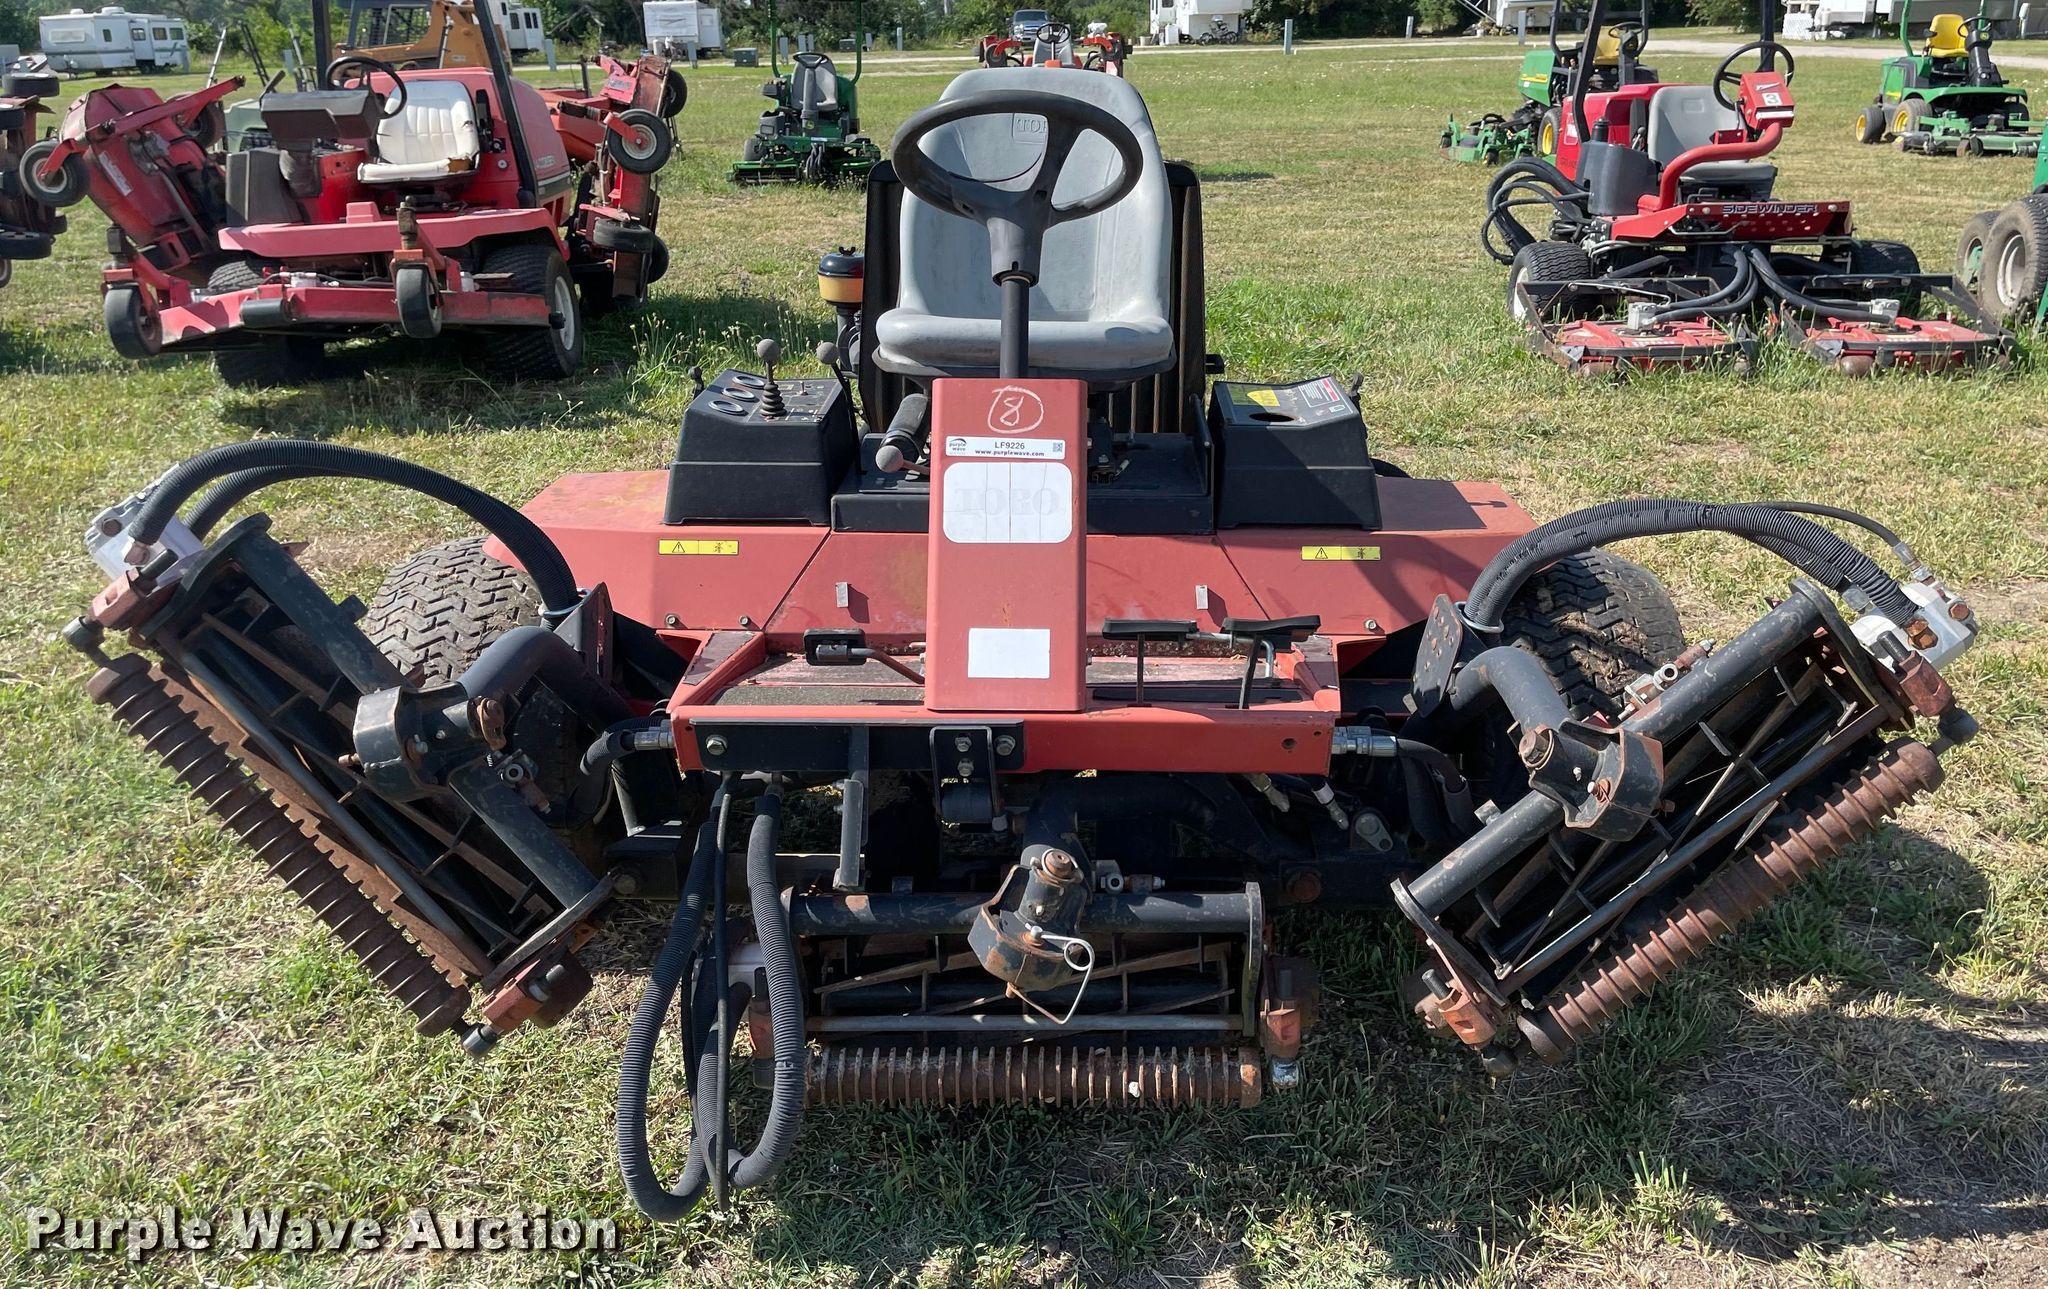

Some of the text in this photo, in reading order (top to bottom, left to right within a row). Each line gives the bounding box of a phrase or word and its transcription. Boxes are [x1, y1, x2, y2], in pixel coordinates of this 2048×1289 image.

[1765, 93, 1780, 105] 3
[1722, 204, 1818, 214] SIDEWINDER
[1000, 396, 1024, 426] 8
[994, 441, 1025, 450] LF9226
[975, 449, 1045, 457] www.purplewave.com
